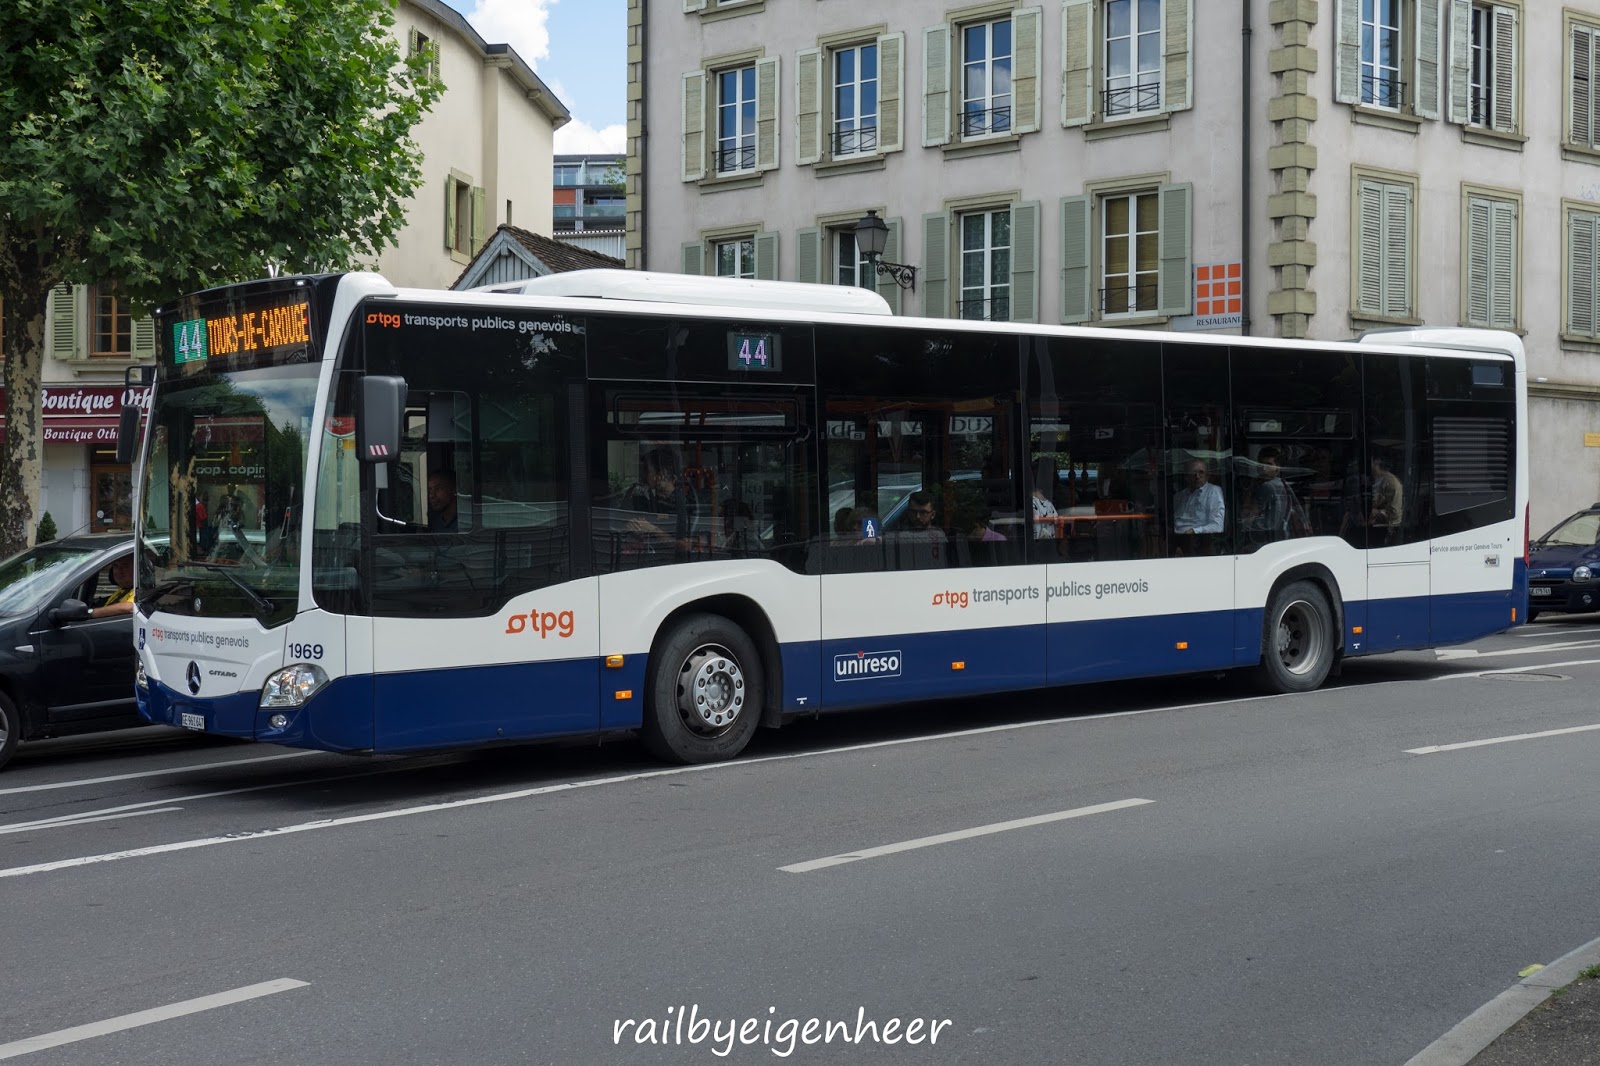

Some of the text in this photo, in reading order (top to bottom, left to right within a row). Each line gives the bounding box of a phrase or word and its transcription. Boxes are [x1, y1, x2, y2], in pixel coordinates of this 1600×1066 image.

[179, 303, 309, 359] 44 TOURS-DE-CAROUGE
[404, 313, 468, 329] transports
[472, 316, 515, 331] publics
[519, 319, 571, 333] genevois
[1196, 316, 1241, 326] RESTAURANT
[739, 339, 767, 365] 44
[44, 428, 93, 442] Boutique
[973, 585, 1039, 605] transports
[1046, 581, 1092, 602] publics
[1095, 578, 1149, 600] genevois
[164, 630, 189, 643] transports
[190, 632, 214, 645] publics
[215, 635, 249, 648] genevois
[288, 642, 324, 660] 1969
[836, 651, 899, 676] unireso
